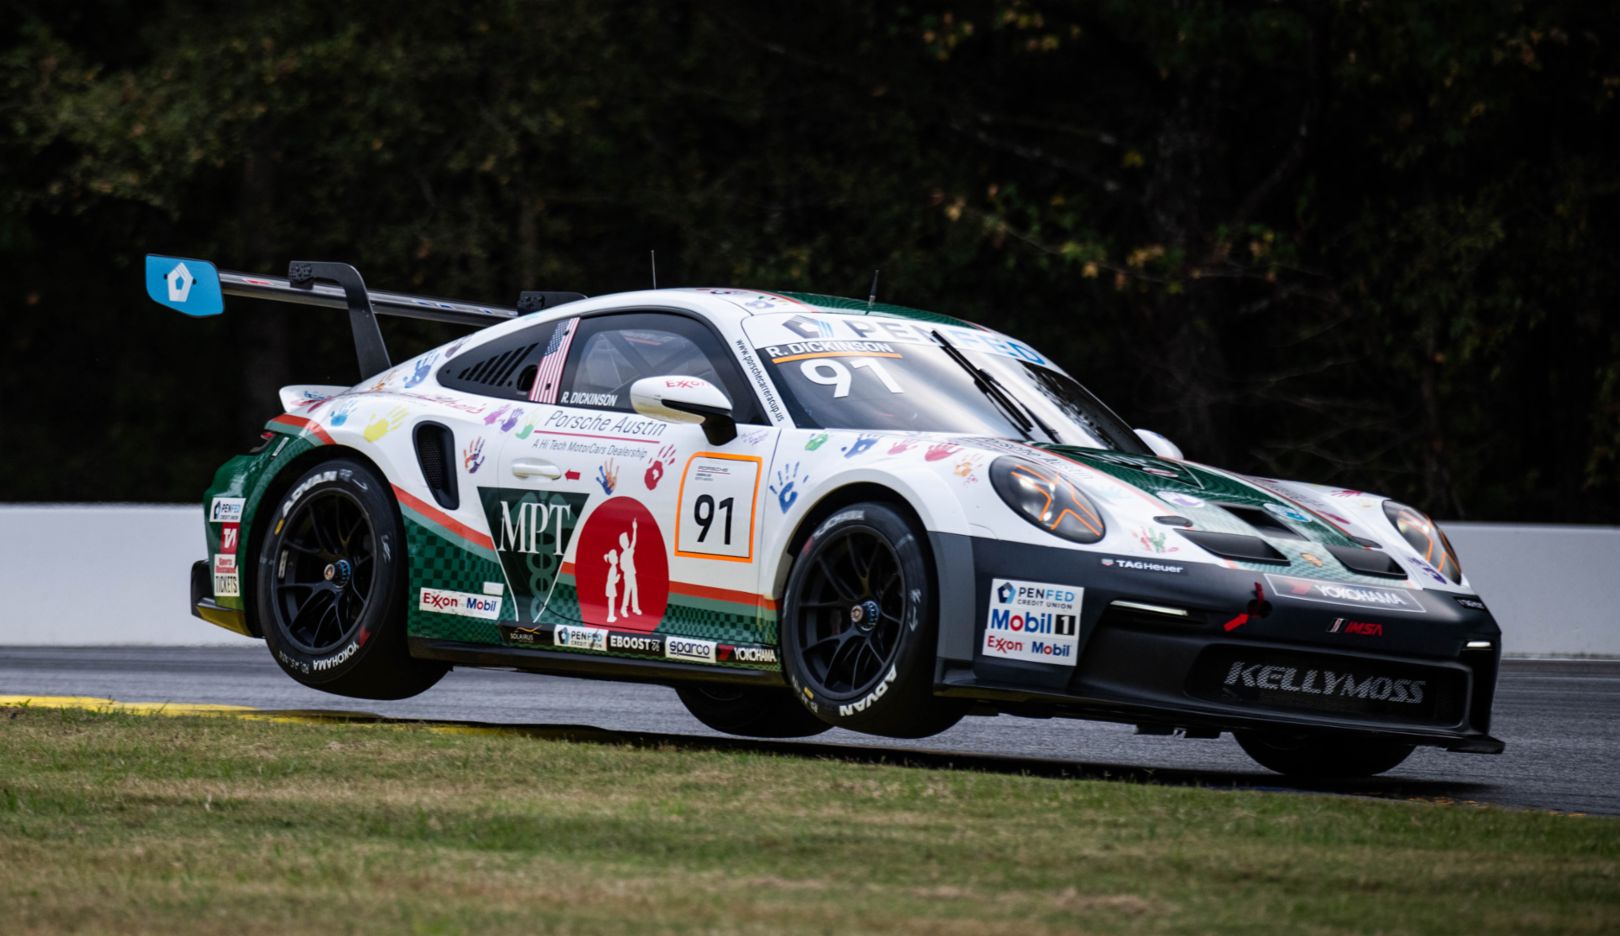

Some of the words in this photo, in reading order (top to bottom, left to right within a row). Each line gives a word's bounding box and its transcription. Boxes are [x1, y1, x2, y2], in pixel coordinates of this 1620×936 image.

[766, 346, 789, 358] R.
[791, 341, 895, 355] DICKINSON
[801, 358, 904, 398] 91
[560, 391, 570, 404] R.
[570, 392, 618, 407] DICKINSON
[545, 409, 611, 432] Porsche
[610, 416, 667, 437] Austin
[532, 439, 540, 448] A
[541, 439, 548, 449] Hi
[550, 440, 567, 450] Tech
[607, 445, 648, 459] Dealership
[497, 499, 572, 556] MPT
[693, 494, 735, 546] 91
[215, 575, 238, 594] TICKETS
[1018, 586, 1075, 602] PENFED
[423, 592, 459, 611] Exxon
[466, 597, 497, 613] Mobil
[1017, 598, 1044, 608] CREDIT
[1046, 601, 1073, 610] UNION
[1315, 584, 1408, 606] YOKOHAMA
[991, 609, 1053, 634] Mobil
[1345, 622, 1384, 637] IMSA
[610, 635, 651, 650] EBOOST
[669, 640, 711, 657] sparco
[987, 635, 1024, 654] Exxon
[1031, 641, 1071, 657] Mobil
[312, 641, 361, 671] YOKOHAMA
[734, 647, 778, 662] YOKOHAMA
[839, 663, 898, 718] ADVAN
